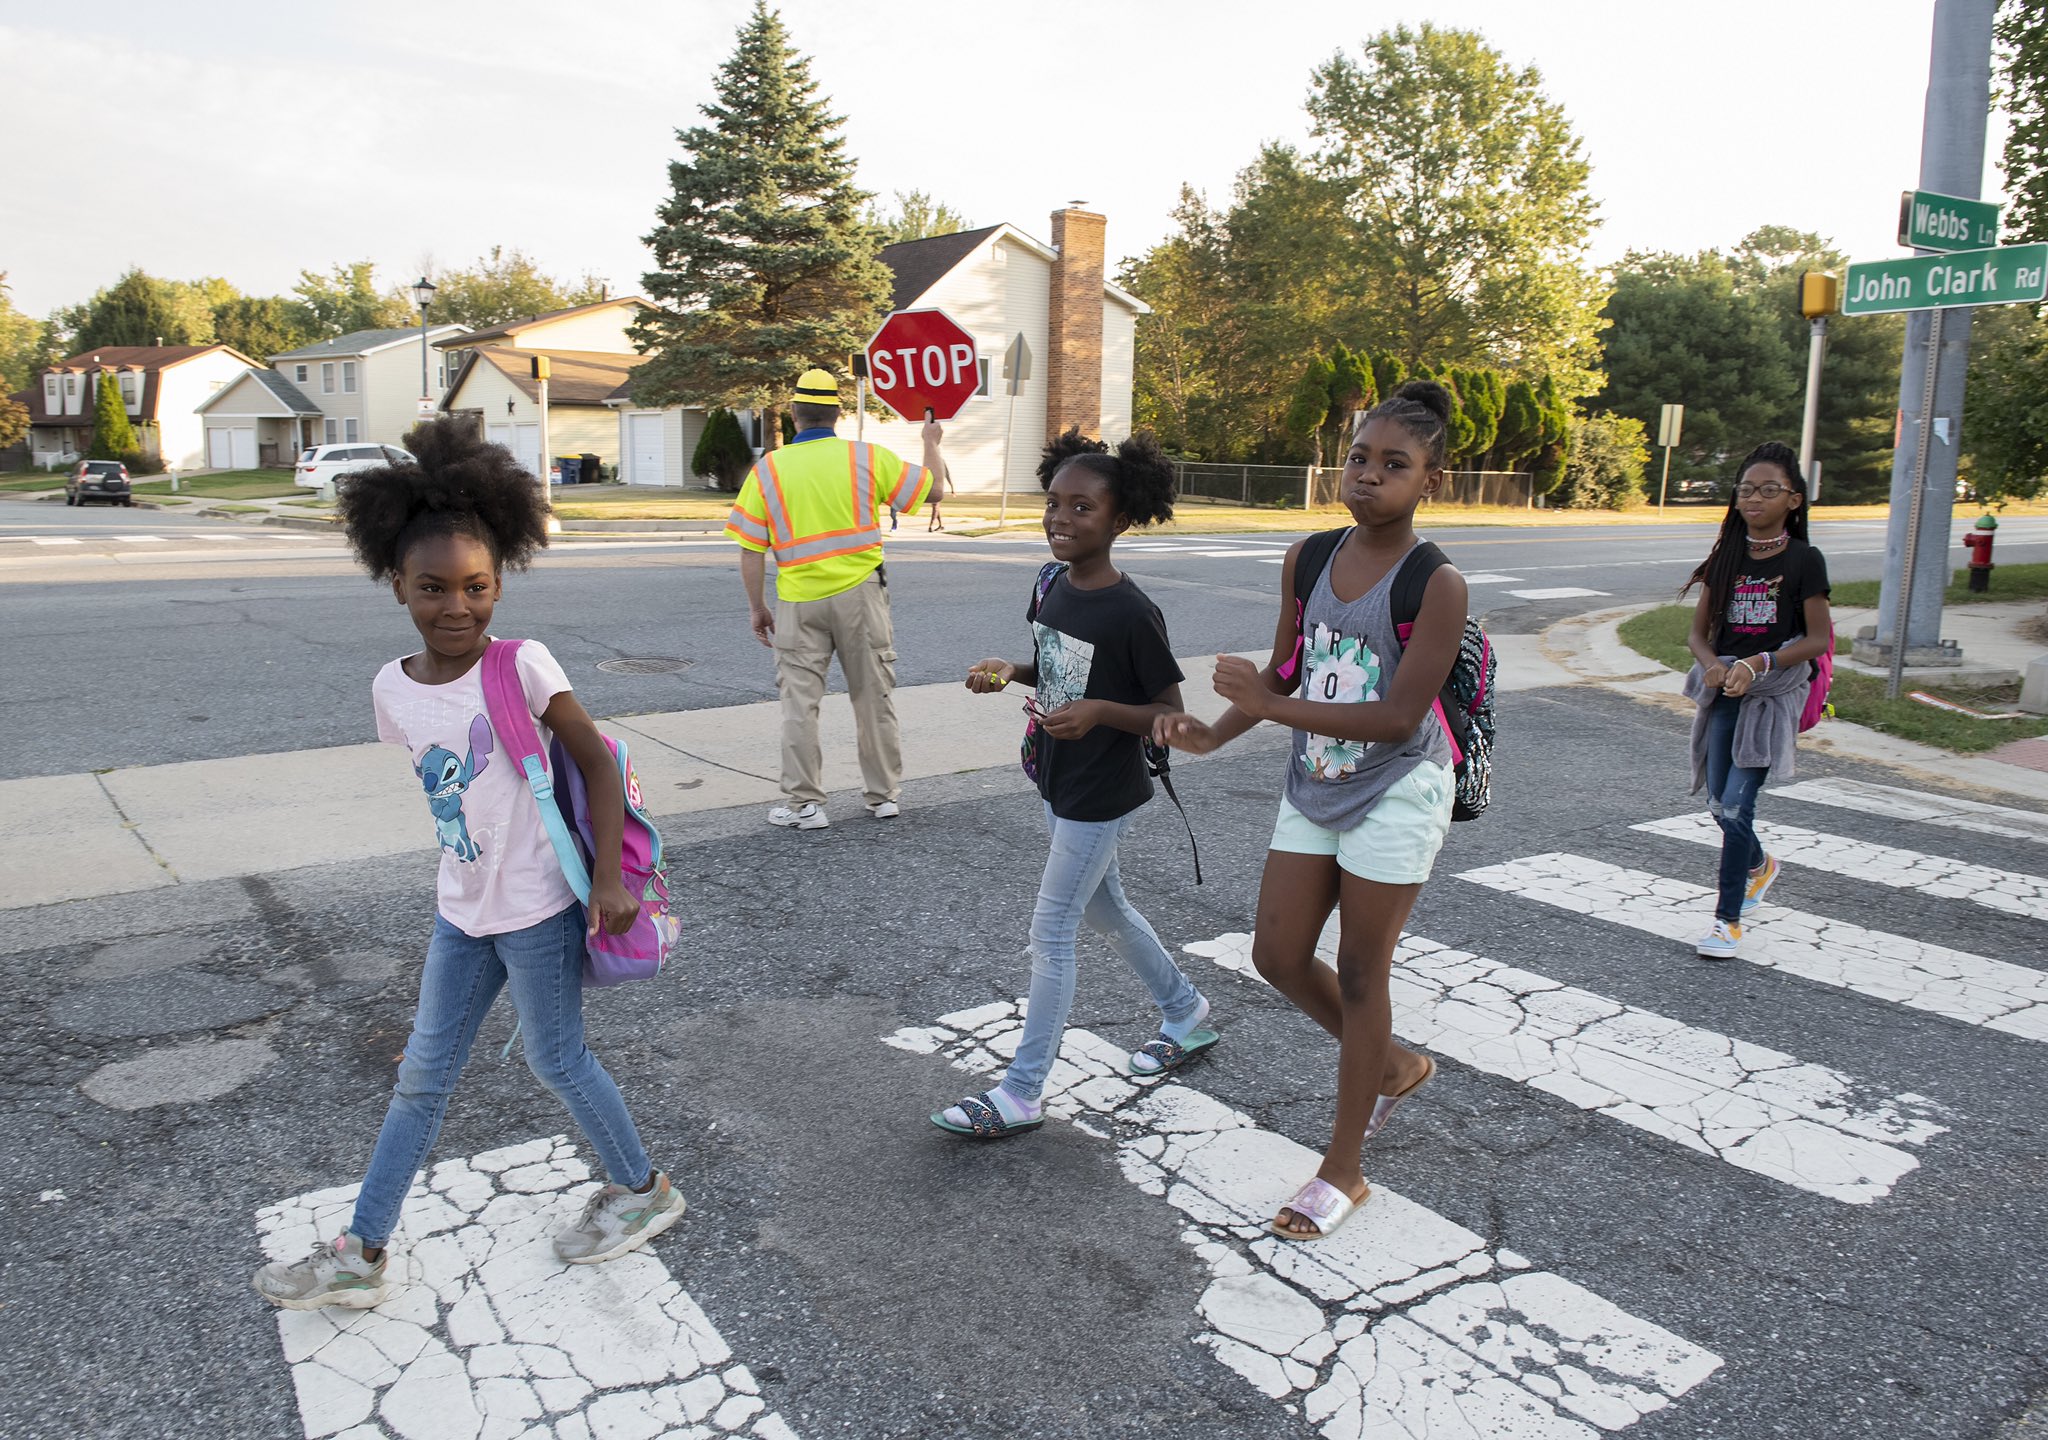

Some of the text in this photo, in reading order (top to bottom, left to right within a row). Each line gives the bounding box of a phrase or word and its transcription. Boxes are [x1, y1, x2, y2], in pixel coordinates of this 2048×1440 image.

[1915, 203, 1994, 245] Webbs Ln
[1851, 261, 2042, 303] John Clark Rd
[872, 343, 974, 390] STOP
[1728, 600, 1778, 624] DIVA
